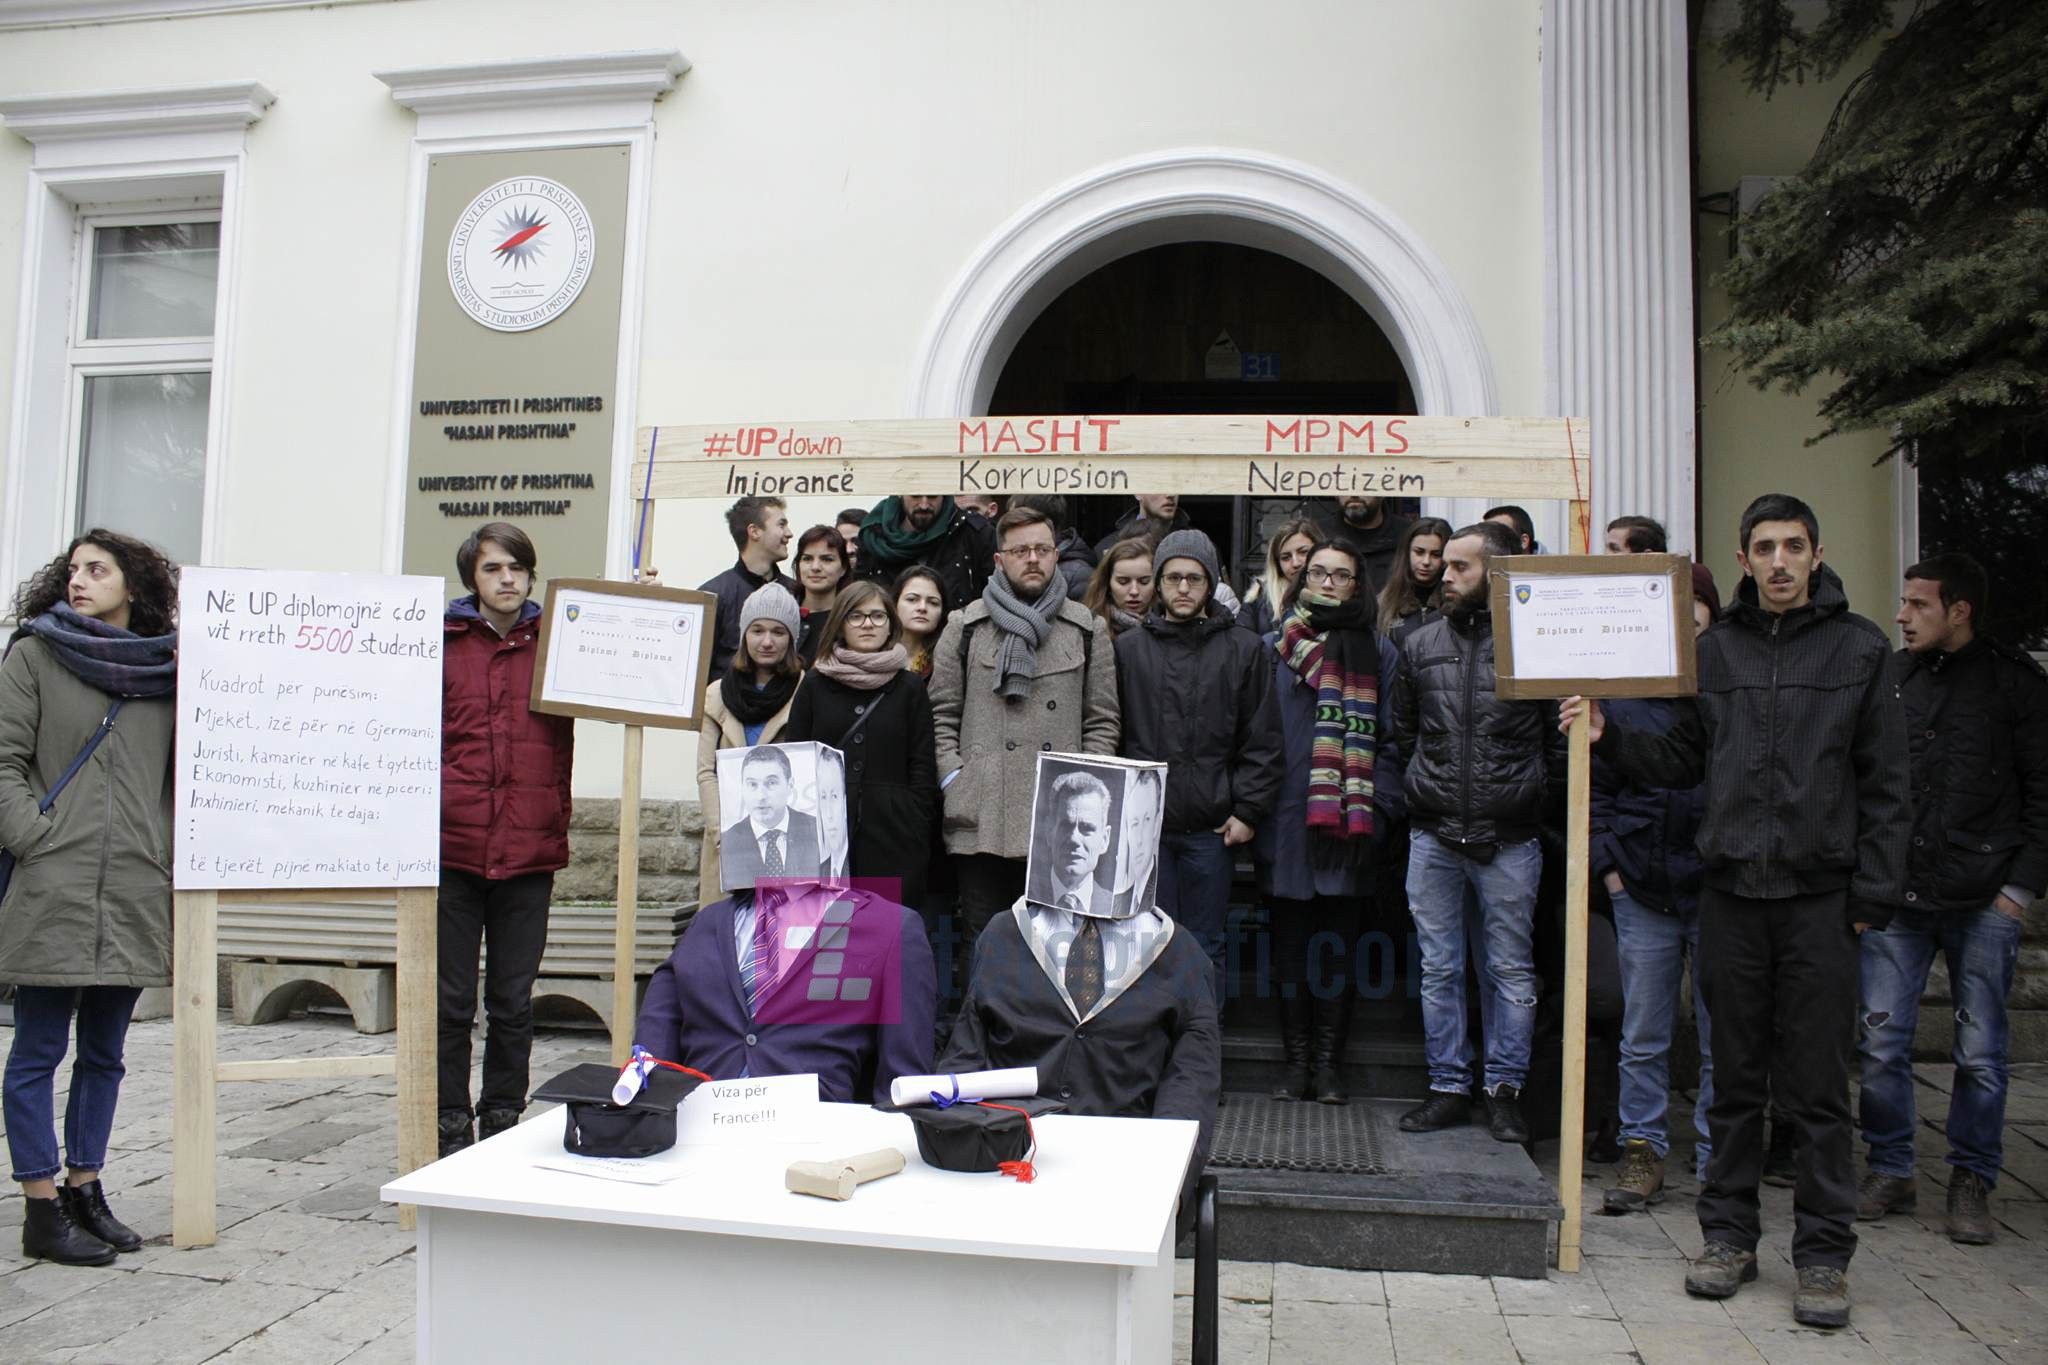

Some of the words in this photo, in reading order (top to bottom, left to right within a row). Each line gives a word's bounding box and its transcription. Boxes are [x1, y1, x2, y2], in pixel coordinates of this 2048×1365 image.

[1246, 355, 1275, 379] 31
[420, 398, 511, 416] UNIVERSITETI
[514, 398, 519, 414] I
[522, 396, 603, 414] PRISHTINES
[703, 427, 842, 457] #UPdown
[959, 418, 1121, 453] MASHT
[1265, 419, 1409, 453] MPMS
[418, 475, 498, 493] UNIVERSITY
[500, 475, 518, 491] OF
[521, 473, 594, 490] PRISHTINA
[726, 464, 854, 496] Injorancë
[959, 459, 1128, 494] Korrupsion
[1247, 460, 1425, 494] Nepotizëm
[206, 590, 236, 614] Në
[249, 591, 278, 616] UP
[283, 593, 382, 629] diplomojnë
[207, 619, 230, 640] vit
[239, 624, 286, 645] rreth
[295, 625, 354, 654] 5500
[358, 632, 439, 659] studentë
[199, 668, 265, 694] Kuadrot
[277, 679, 304, 701] për
[268, 716, 292, 731] izë
[299, 719, 328, 738] për
[250, 744, 316, 766] kamarier
[293, 772, 362, 795] kuzhinier
[266, 799, 324, 817] mekanik
[190, 852, 206, 872] të
[215, 855, 265, 879] tjerët
[315, 856, 371, 873] makiato
[712, 1086, 740, 1100] Viza
[744, 1084, 769, 1101] për
